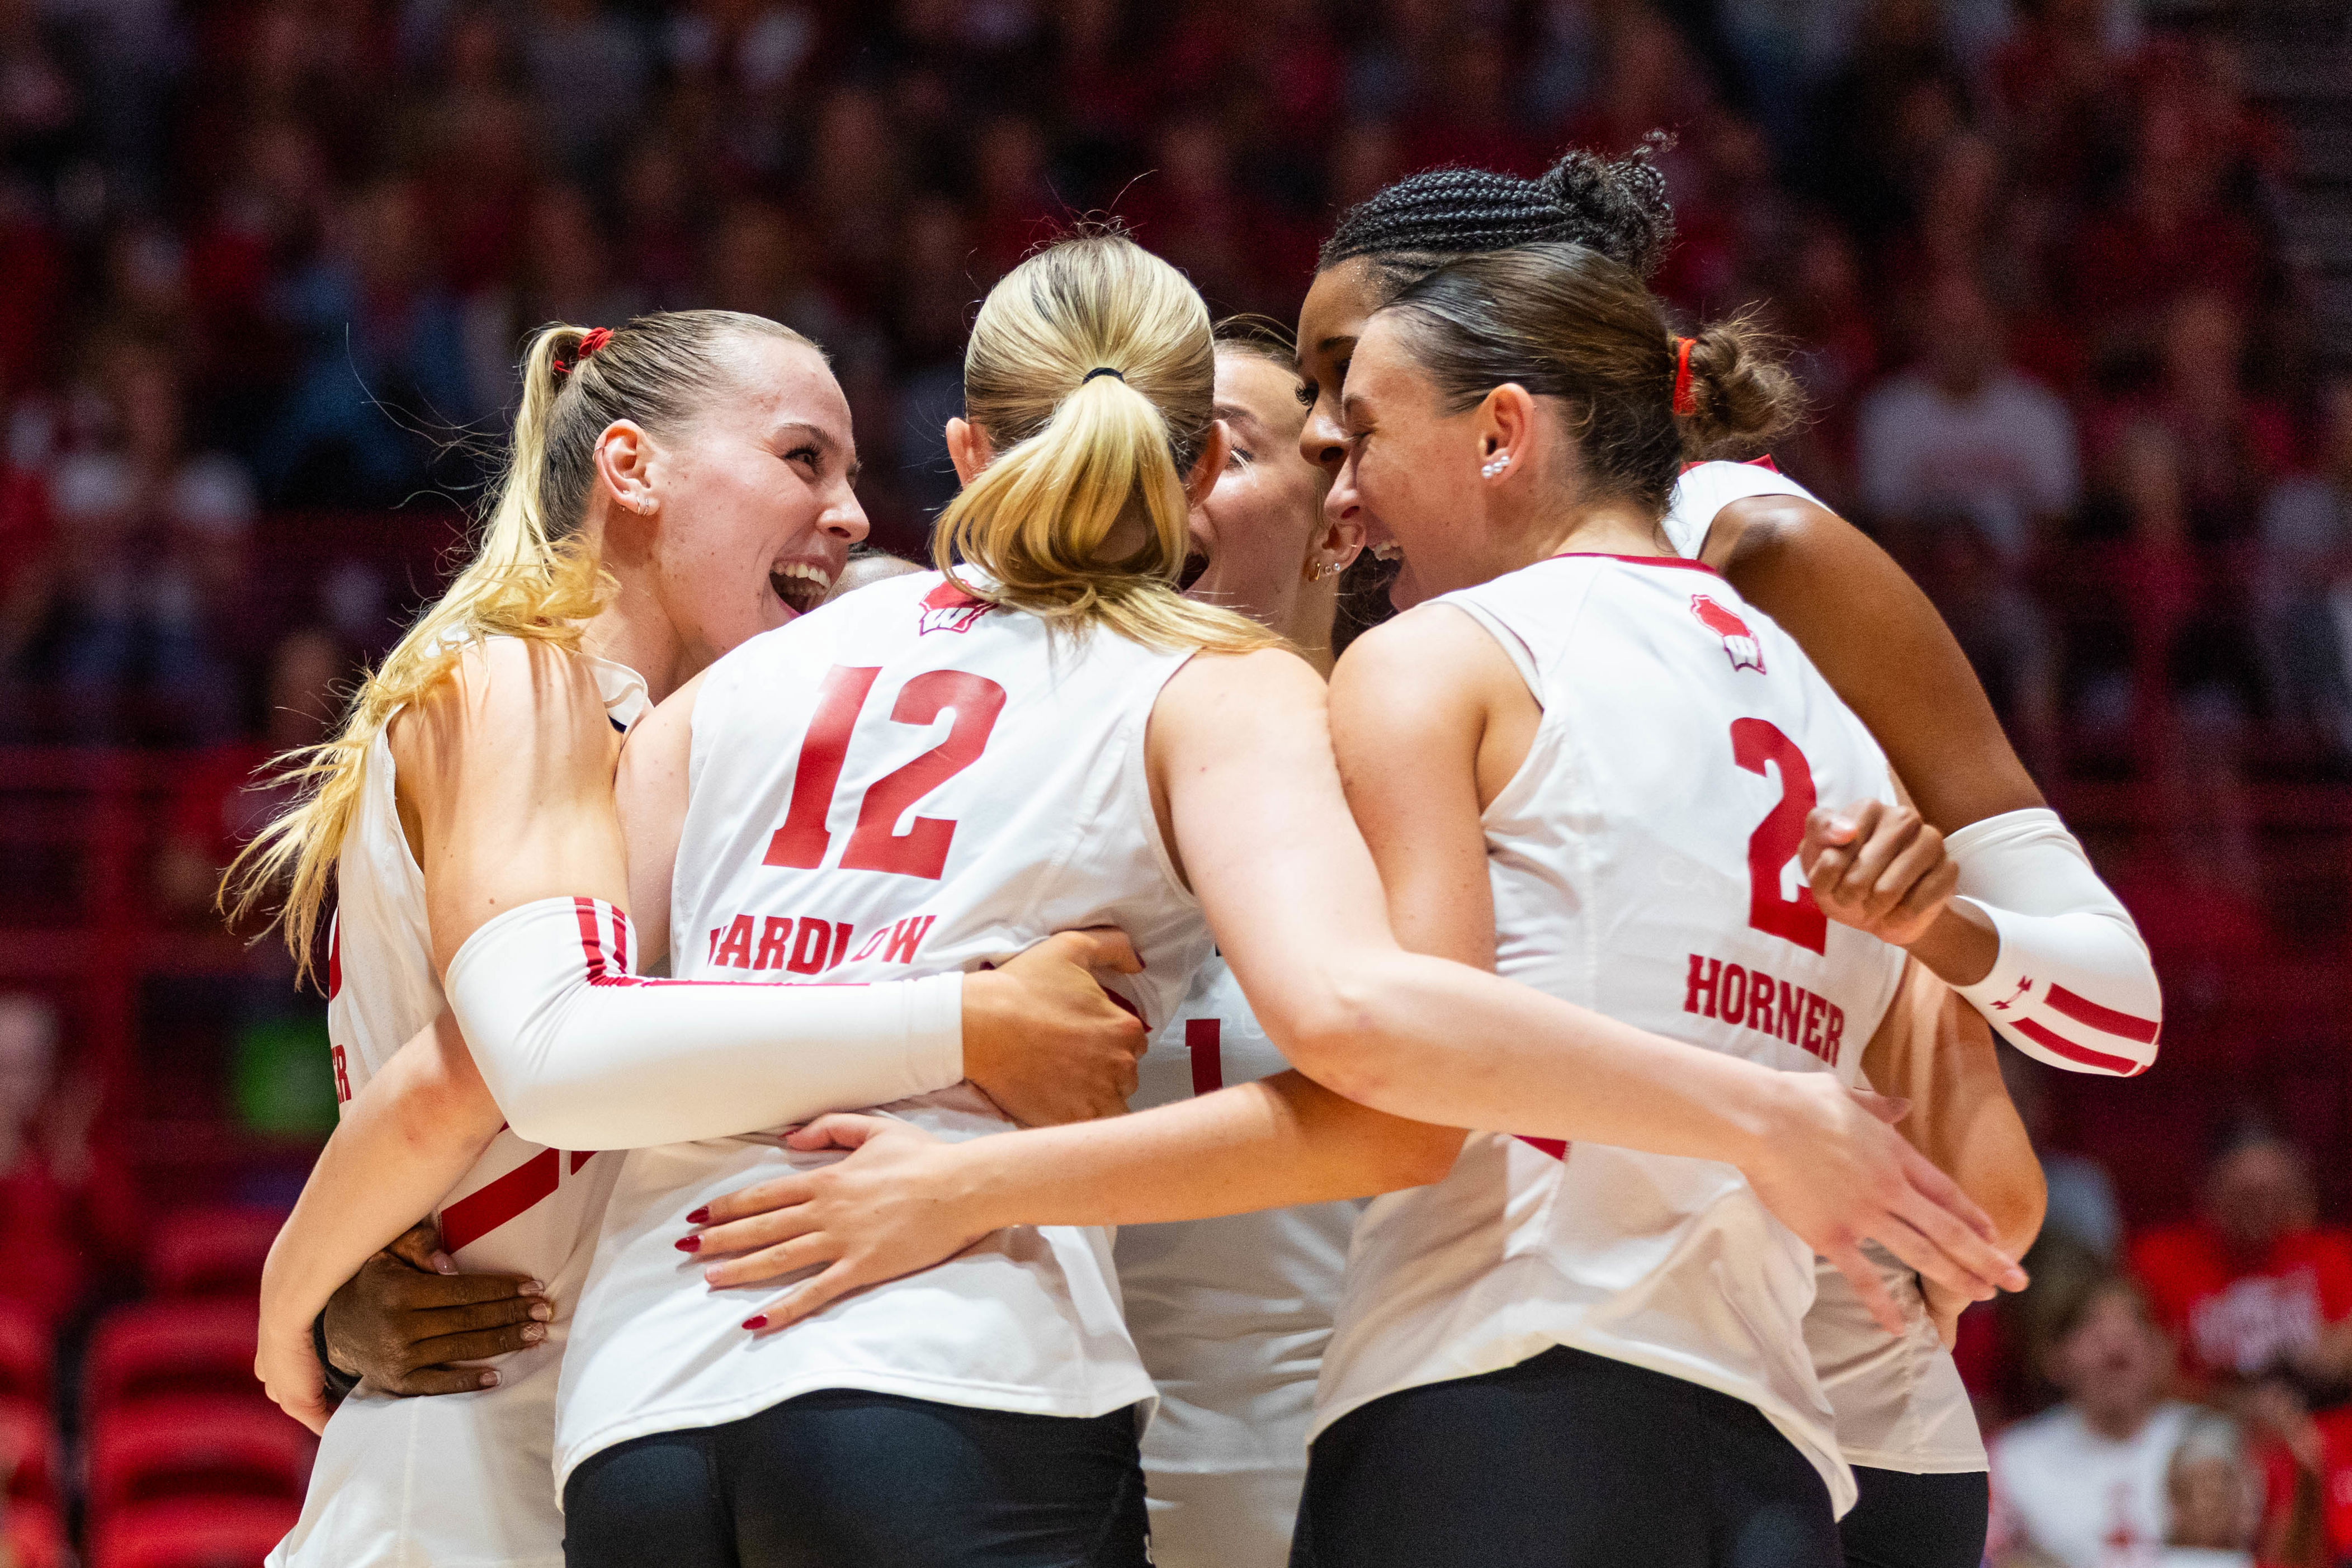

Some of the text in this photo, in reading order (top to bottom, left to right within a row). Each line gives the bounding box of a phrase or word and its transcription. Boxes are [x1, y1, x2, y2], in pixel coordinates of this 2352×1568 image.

[762, 664, 1007, 881] 12
[1730, 717, 1827, 957] 2
[1683, 953, 1845, 1068] HORNER
